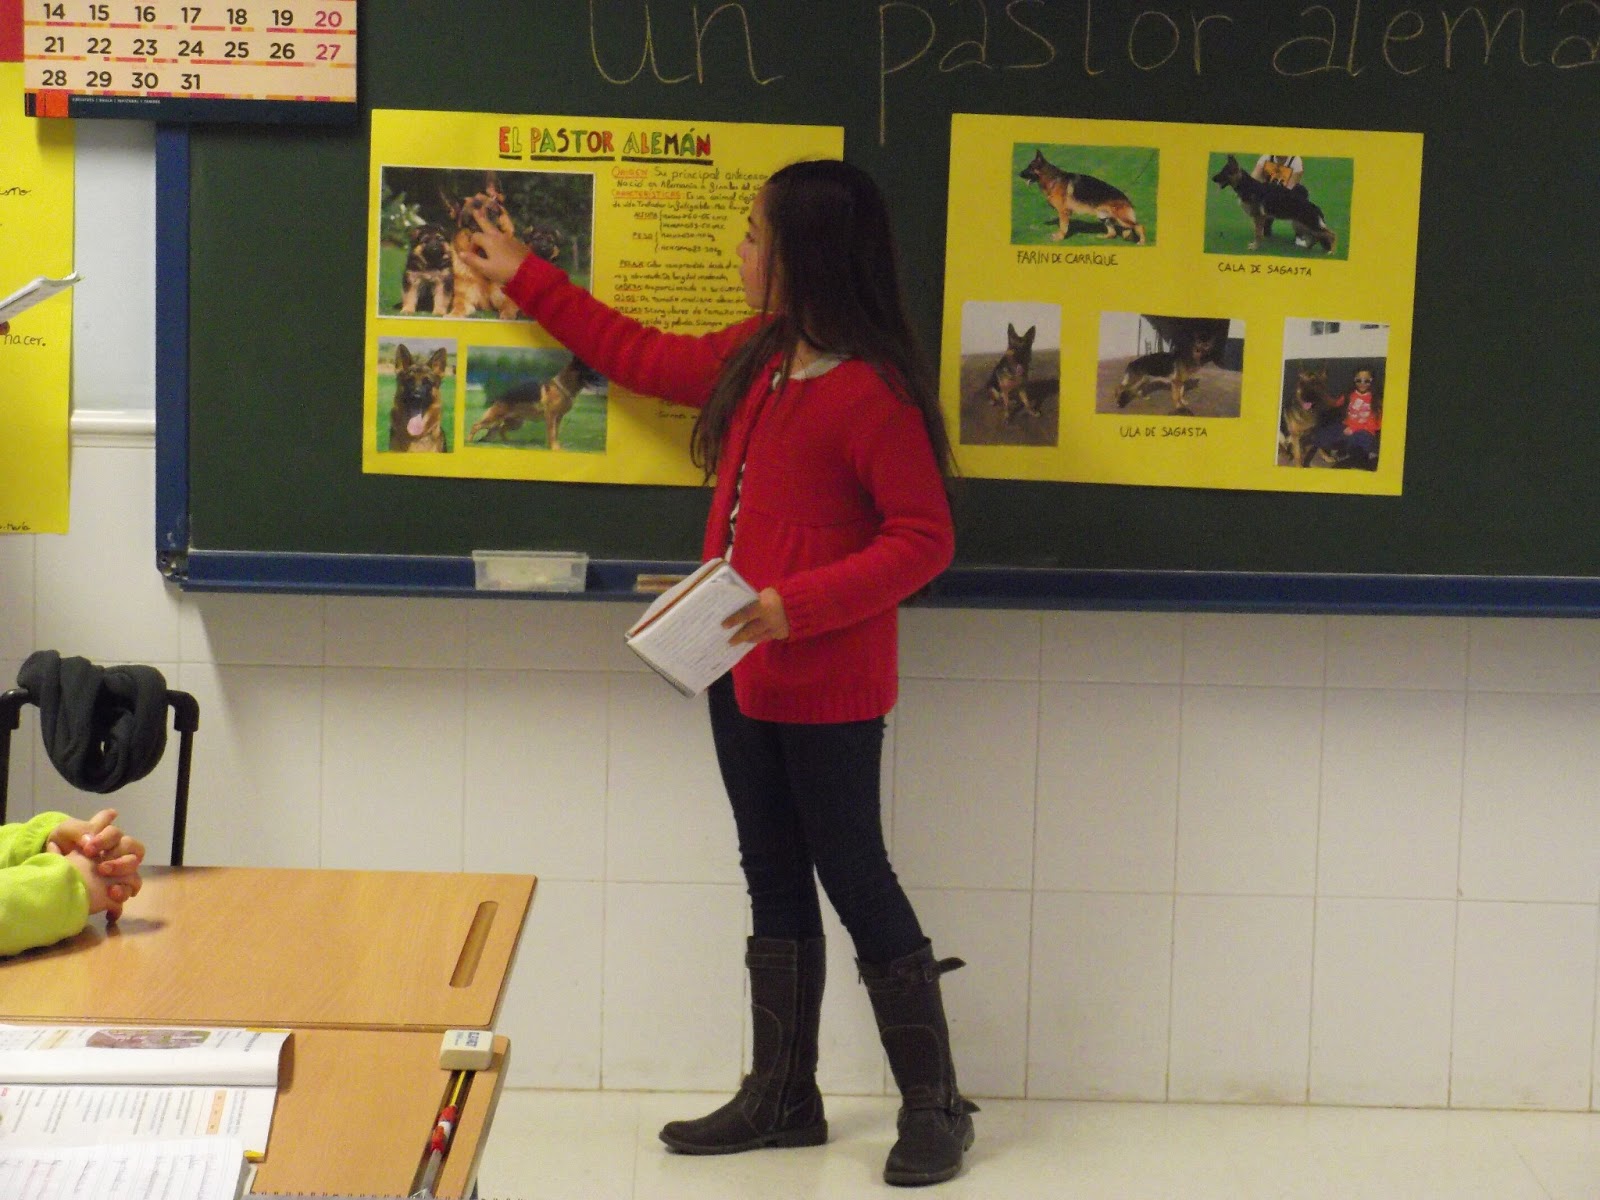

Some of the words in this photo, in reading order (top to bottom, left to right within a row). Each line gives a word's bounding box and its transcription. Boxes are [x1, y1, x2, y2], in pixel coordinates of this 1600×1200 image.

[43, 3, 65, 20] 14
[89, 5, 110, 21] 15
[135, 6, 156, 23] 16
[181, 7, 202, 24] 17
[227, 8, 248, 25] 18
[272, 9, 294, 26] 19
[315, 10, 343, 28] 20
[44, 36, 64, 53] 21
[87, 37, 112, 55] 22
[133, 38, 158, 56] 23
[178, 41, 204, 58] 24
[224, 41, 249, 59] 25
[269, 42, 295, 60] 26
[316, 43, 341, 61] 27
[42, 70, 67, 87] 28
[86, 71, 112, 88] 29
[131, 72, 159, 90] 30
[181, 74, 201, 90] 31
[499, 126, 523, 154] EL
[530, 127, 615, 155] PASTOR
[622, 127, 712, 157] ALEMÁN
[660, 179, 698, 189] Alemania
[672, 167, 720, 184] principal
[1218, 262, 1245, 273] CALA
[1251, 264, 1261, 273] DE
[1267, 264, 1312, 276] SAGASTA
[1120, 426, 1141, 438] ULA
[1145, 427, 1156, 437] DE
[1162, 427, 1207, 438] SAGASTA
